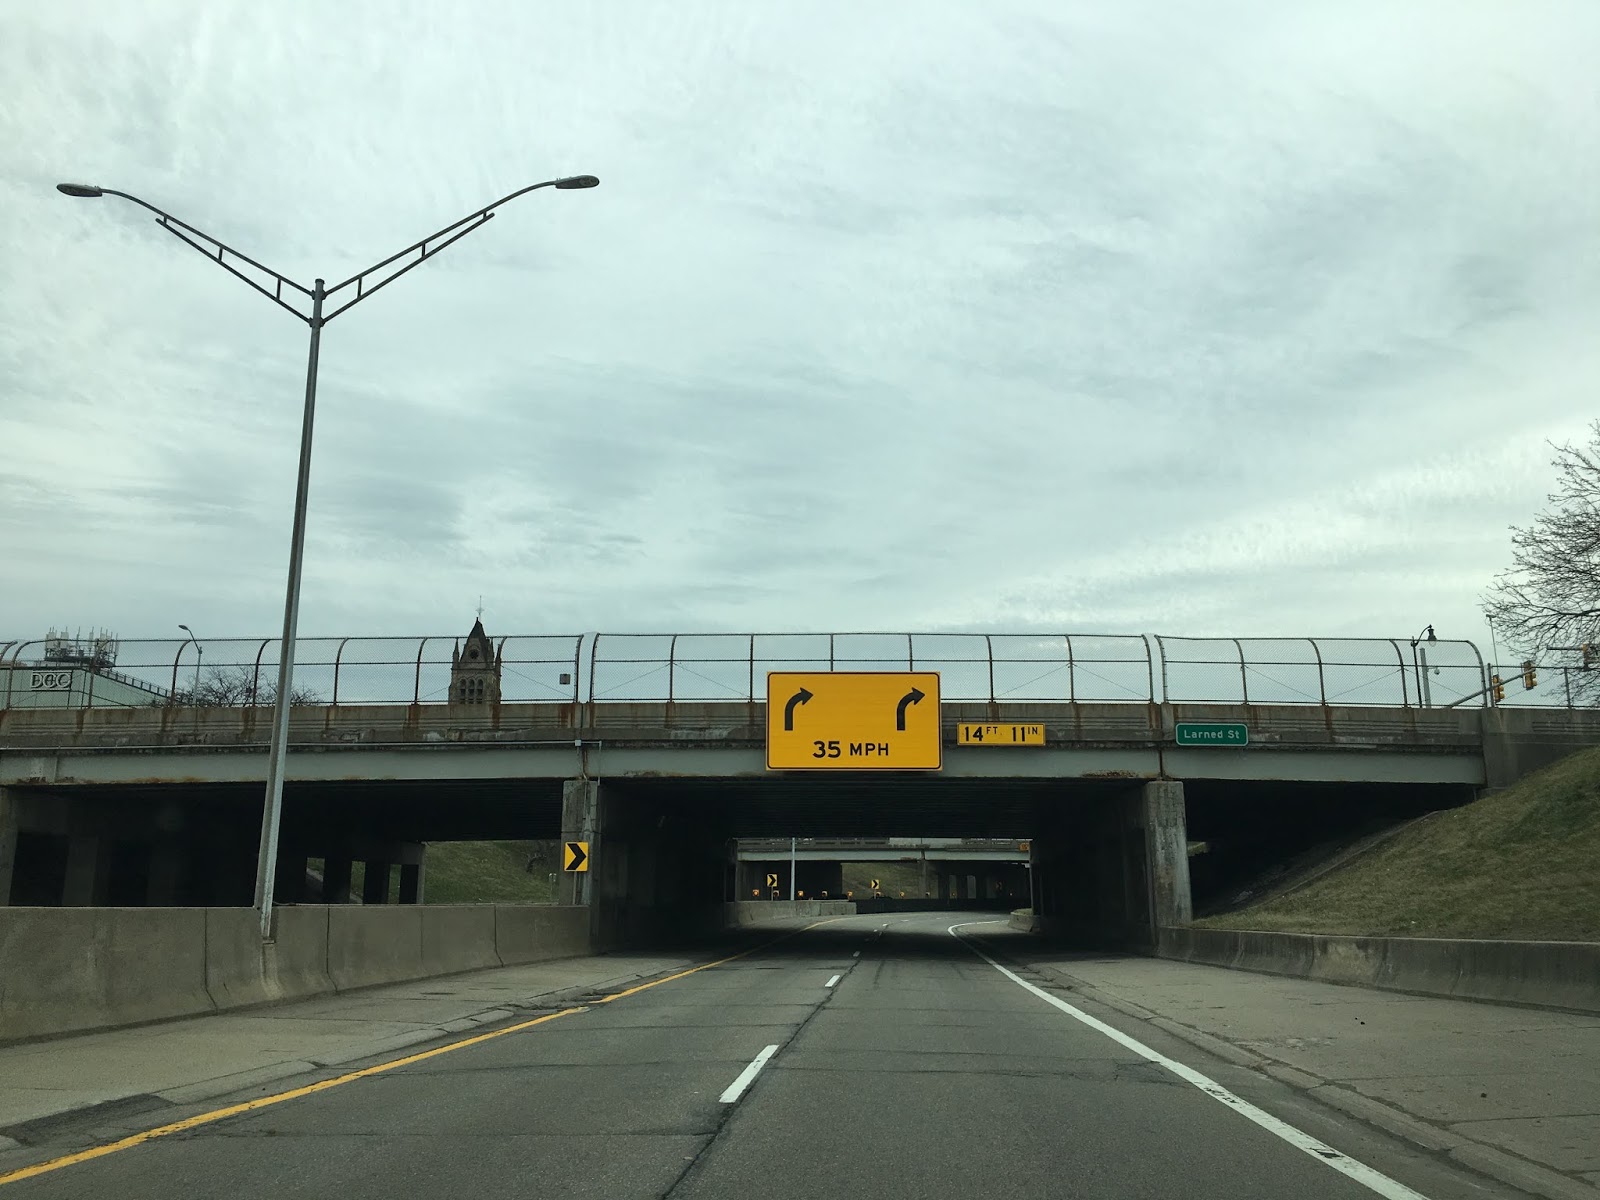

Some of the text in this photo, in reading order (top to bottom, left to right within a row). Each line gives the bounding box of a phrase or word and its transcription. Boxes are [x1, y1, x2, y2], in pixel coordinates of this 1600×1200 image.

[965, 726, 1038, 742] 14 FT 11 IN
[1184, 729, 1240, 739] Larned St
[812, 740, 889, 758] 35 MPH
